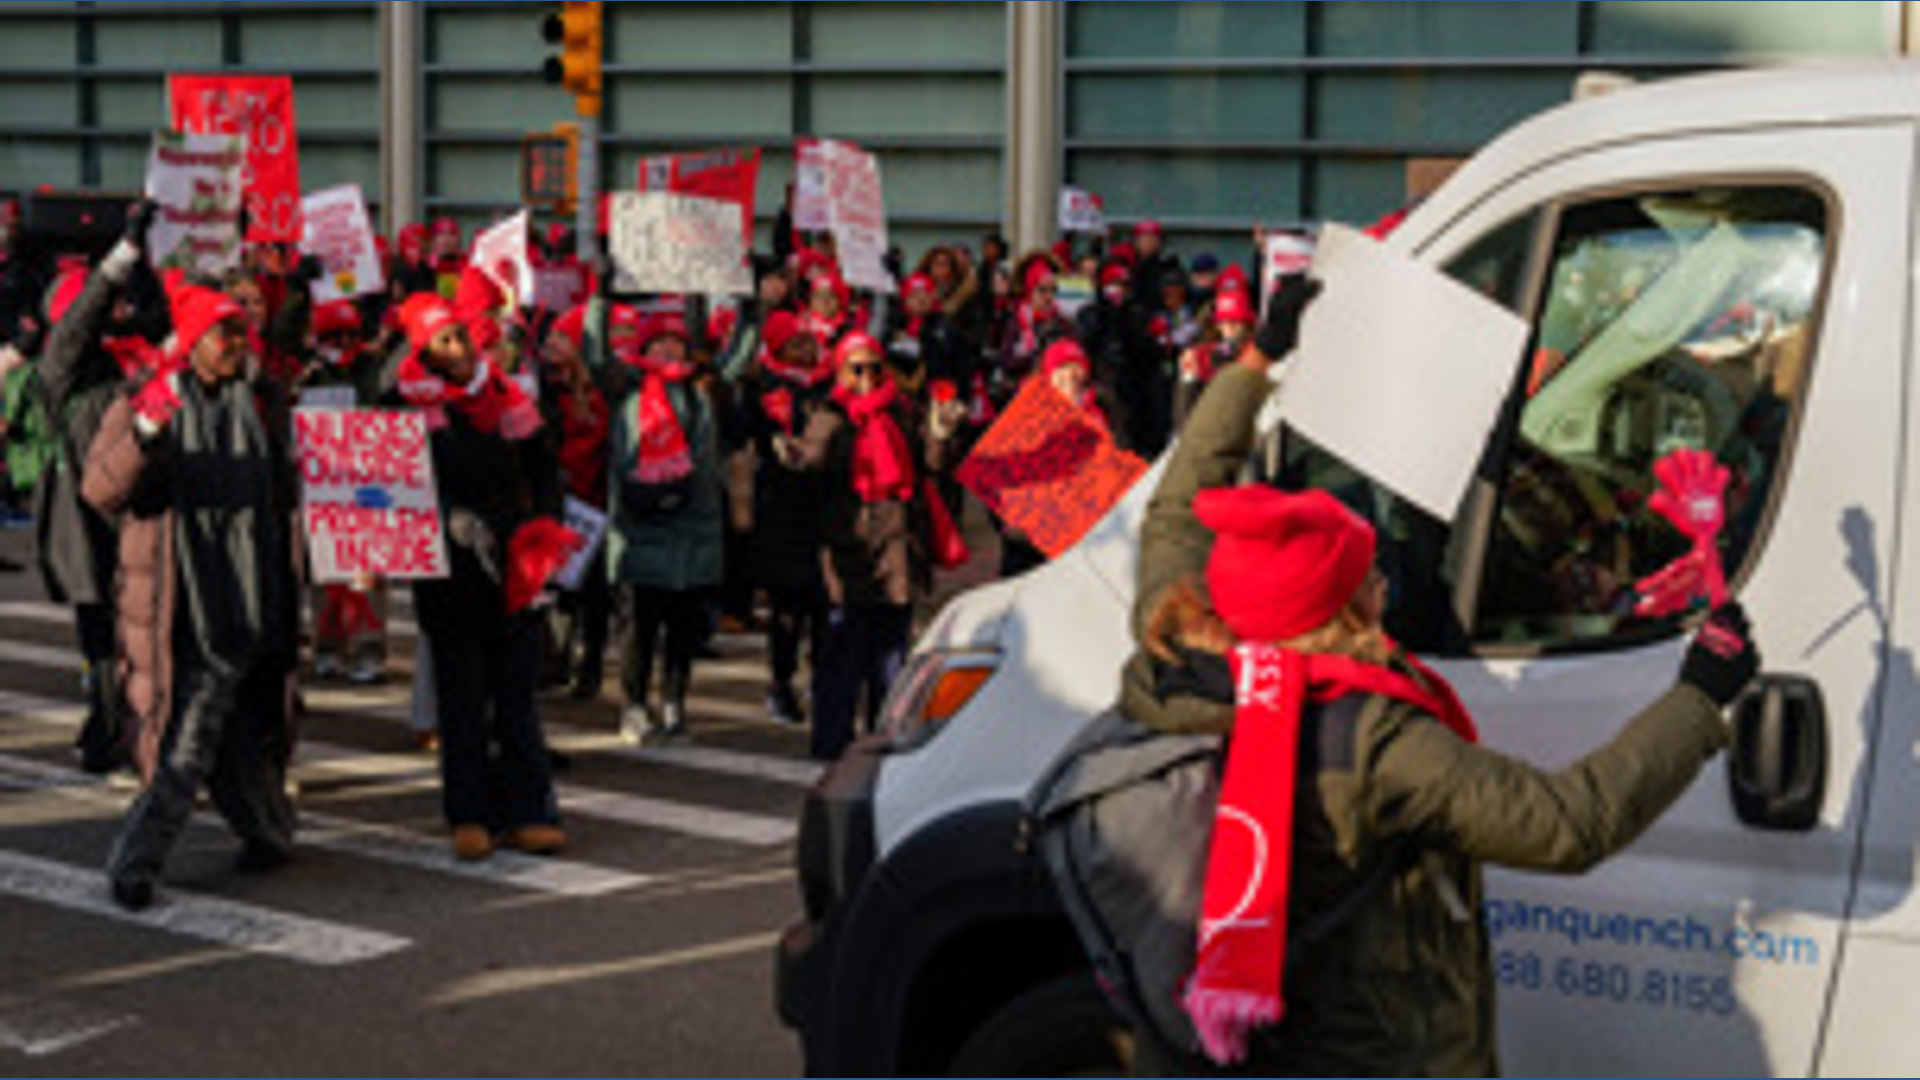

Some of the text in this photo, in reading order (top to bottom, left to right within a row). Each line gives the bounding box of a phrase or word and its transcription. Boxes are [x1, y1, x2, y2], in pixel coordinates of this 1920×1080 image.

[296, 411, 426, 447] NURSES
[298, 446, 426, 489] OUTSIDE
[308, 500, 440, 536] PROBLEM
[335, 535, 439, 573] INSIDE
